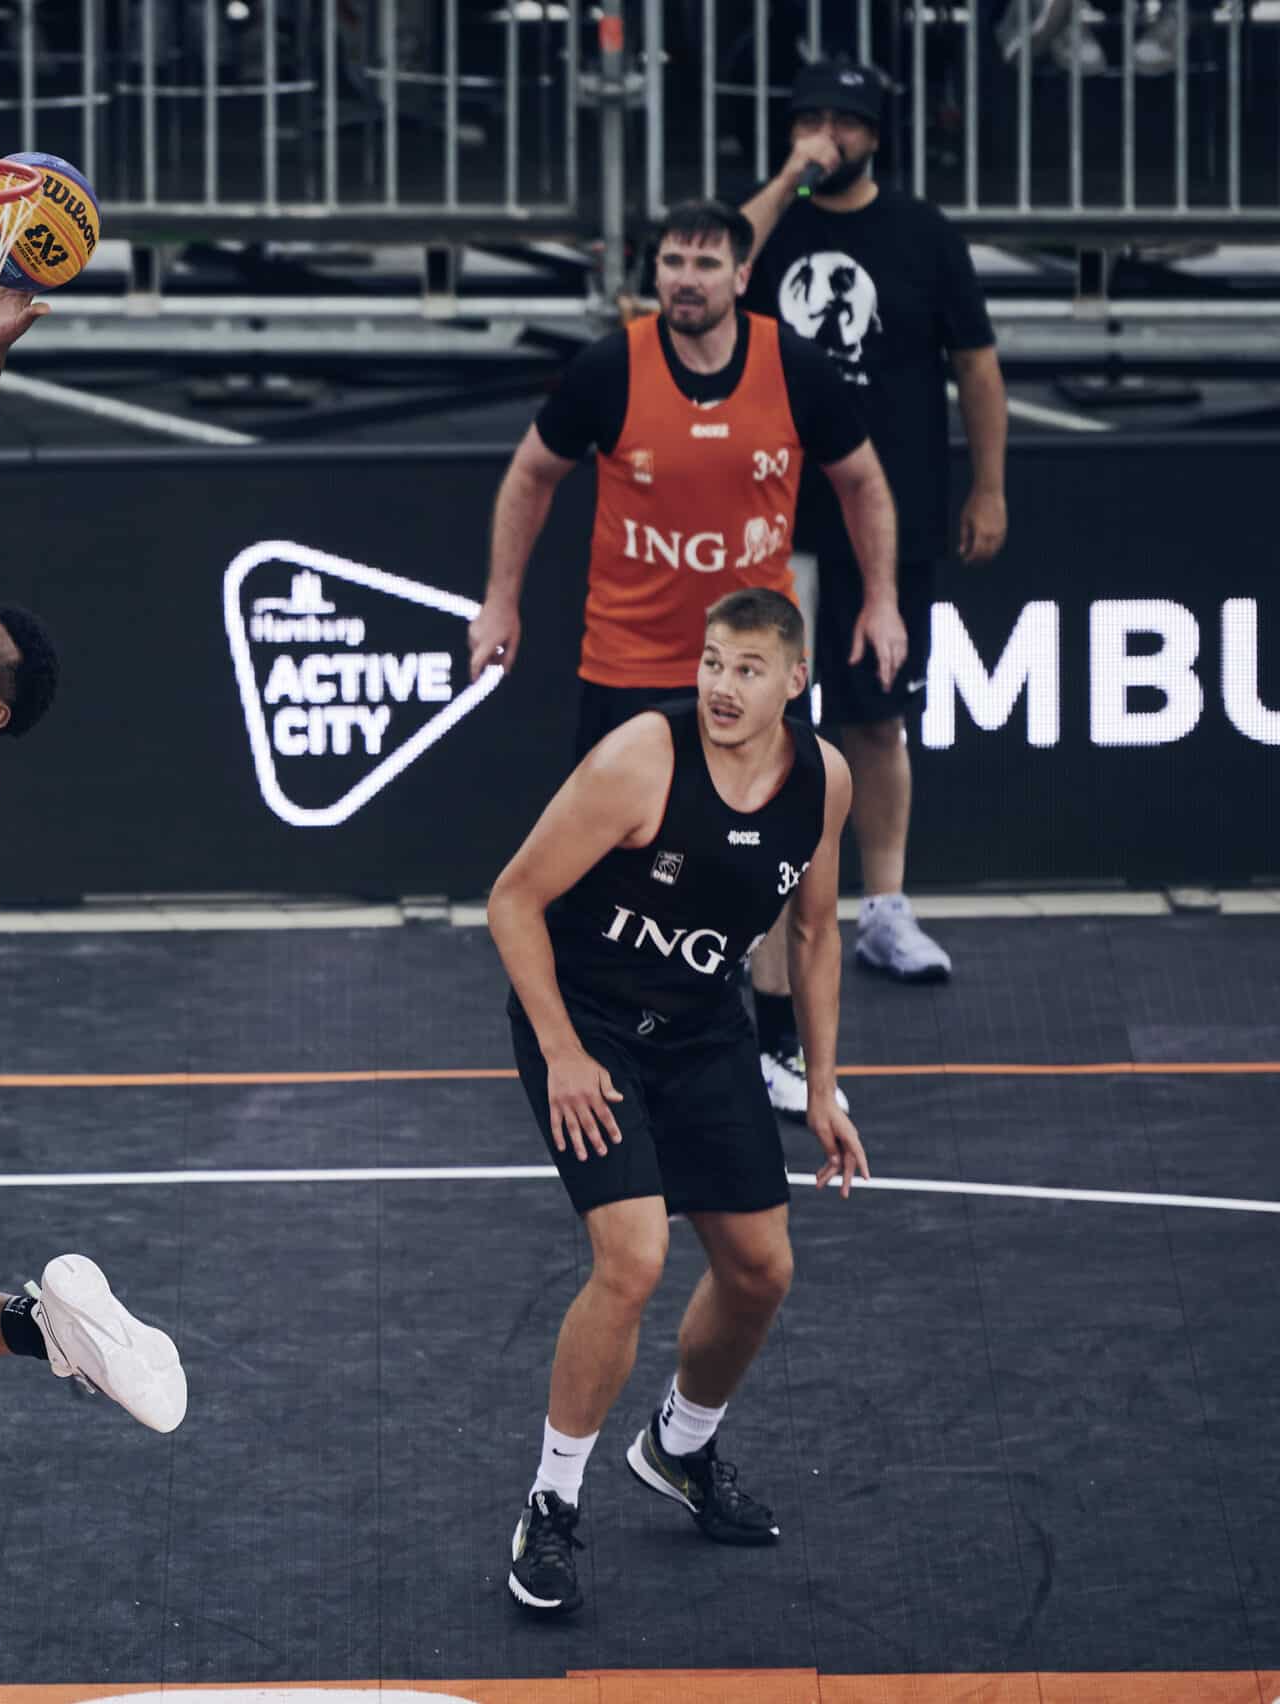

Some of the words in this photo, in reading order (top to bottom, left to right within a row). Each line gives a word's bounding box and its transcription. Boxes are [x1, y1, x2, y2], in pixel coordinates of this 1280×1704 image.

[42, 174, 96, 256] Wilson
[623, 517, 727, 573] ING
[263, 652, 452, 704] ACTIVE
[273, 704, 391, 756] CITY
[601, 904, 728, 975] ING
